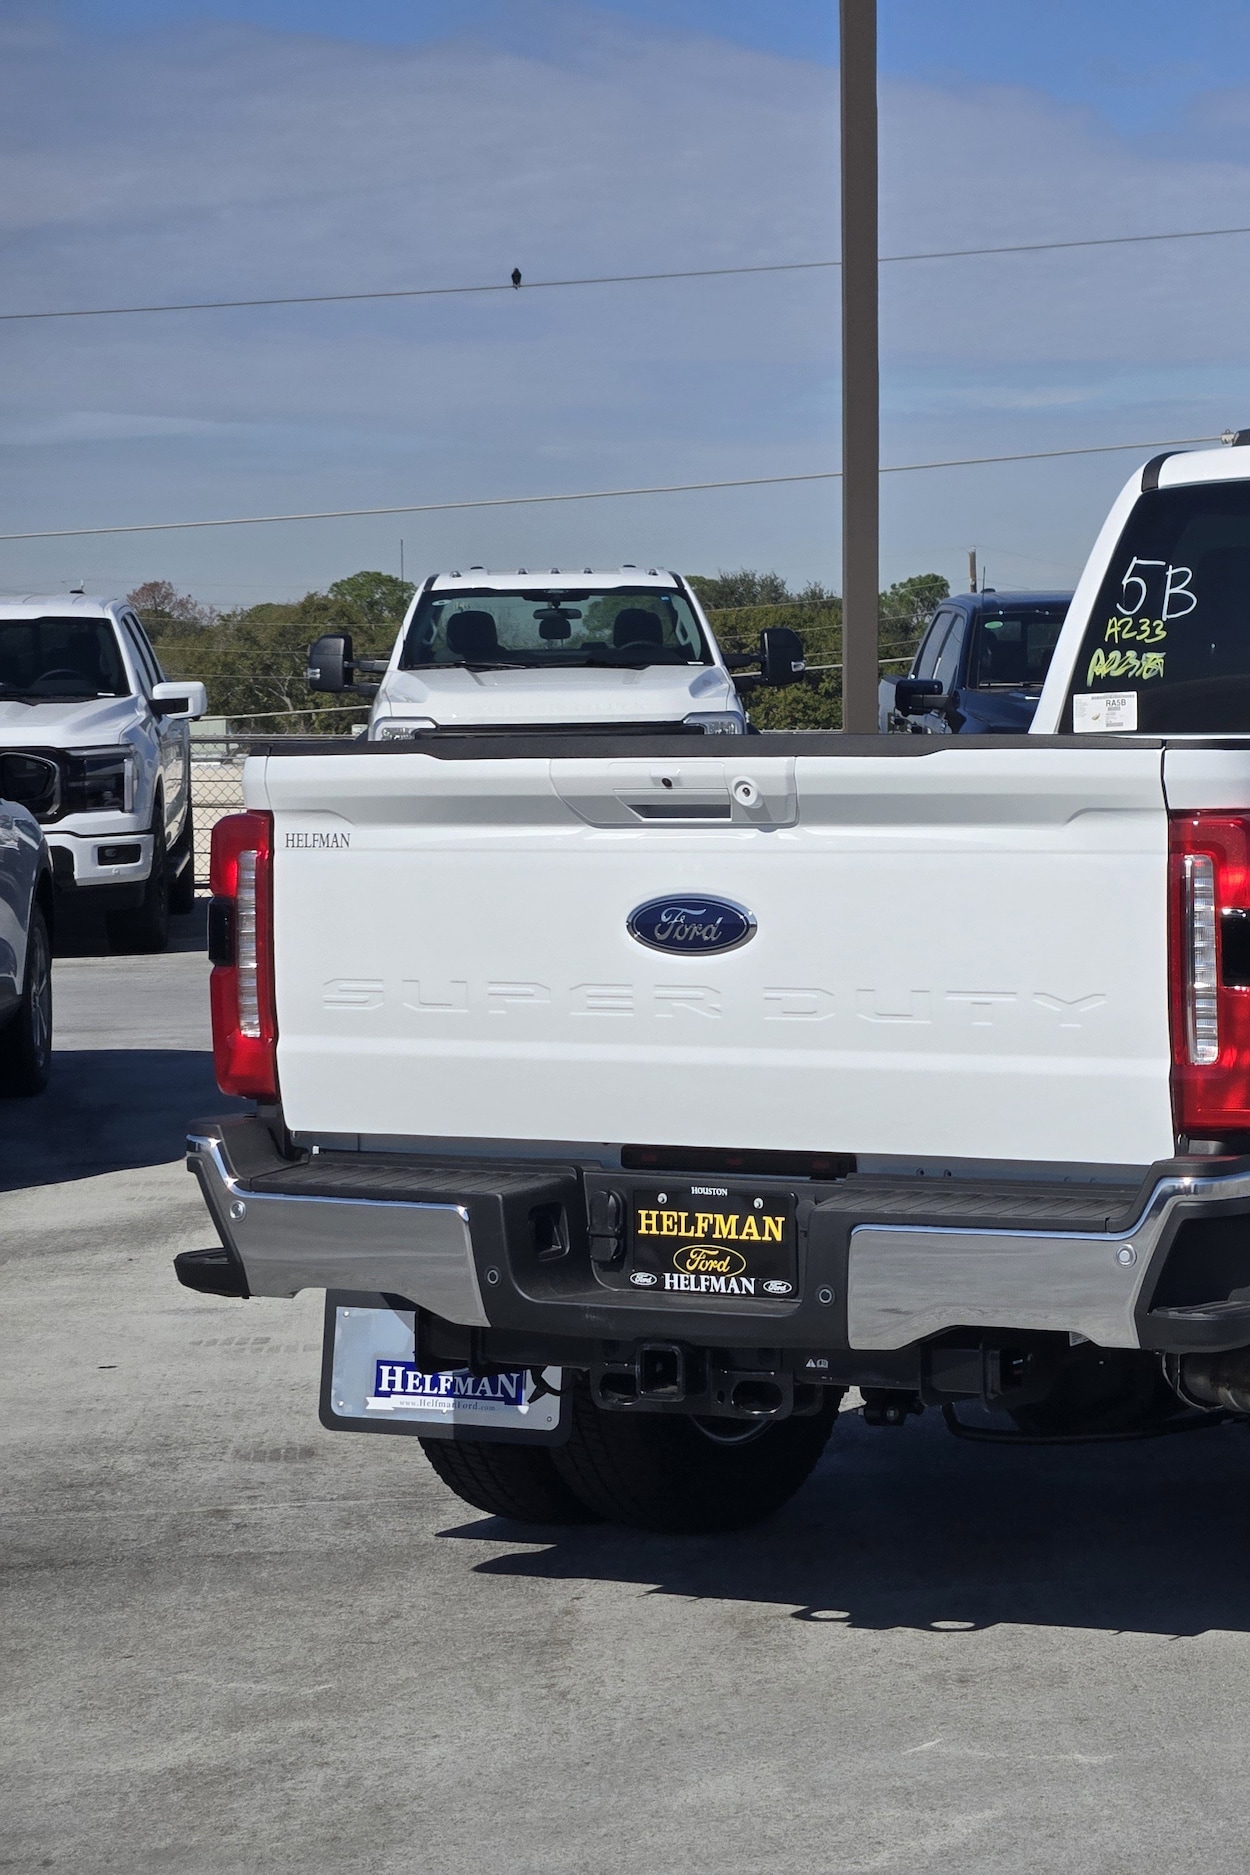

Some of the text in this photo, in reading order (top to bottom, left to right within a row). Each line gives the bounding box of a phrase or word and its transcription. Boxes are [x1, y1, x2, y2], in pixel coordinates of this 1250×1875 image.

[1104, 616, 1167, 644] A233
[1105, 698, 1127, 707] RA5B
[285, 832, 351, 848] HELFMAN
[654, 906, 724, 941] Ford
[323, 979, 1107, 1028] SUPER DUTY
[691, 1186, 728, 1197] HOUSTON
[637, 1209, 786, 1242] HELFMAN
[685, 1248, 731, 1273] Ford
[663, 1273, 756, 1295] HELFMAN
[378, 1365, 521, 1398] HELFMAN
[399, 1399, 496, 1412] www.HelfmanFord.com
